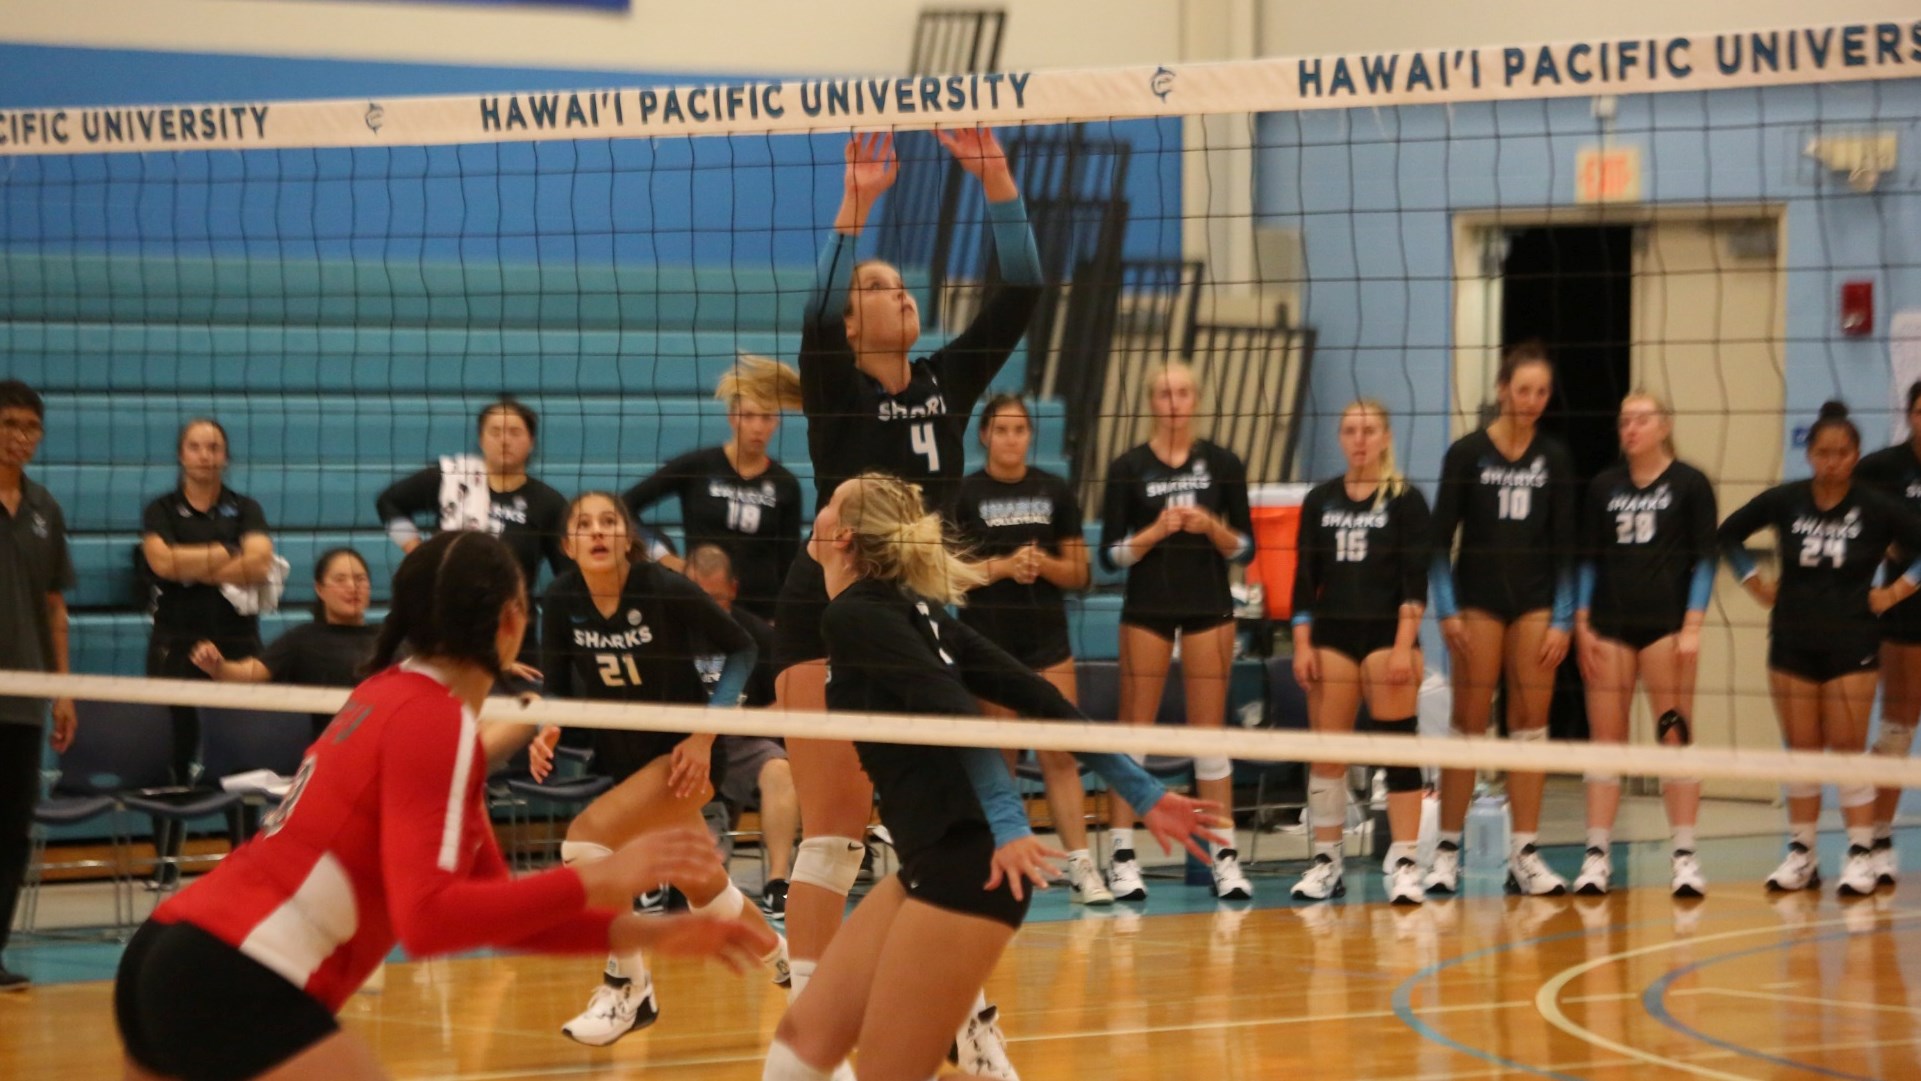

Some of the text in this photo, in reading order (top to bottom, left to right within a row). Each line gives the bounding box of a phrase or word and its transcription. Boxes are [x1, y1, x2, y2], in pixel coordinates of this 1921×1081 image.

[1503, 37, 1693, 87] PACIFIC
[639, 83, 785, 125] PACIFIC
[801, 72, 1030, 117] UNIVERSITY
[82, 105, 270, 143] UNIVERSITY
[911, 422, 940, 471] 4
[1146, 474, 1211, 497] SHARKS
[1480, 468, 1548, 488] SHARKS
[1320, 509, 1388, 529] SHARKS
[1497, 487, 1531, 520] 10
[1791, 516, 1862, 540] SHARKS
[1799, 537, 1846, 568] 24
[573, 625, 653, 649] SHARKS
[595, 653, 643, 686] 21
